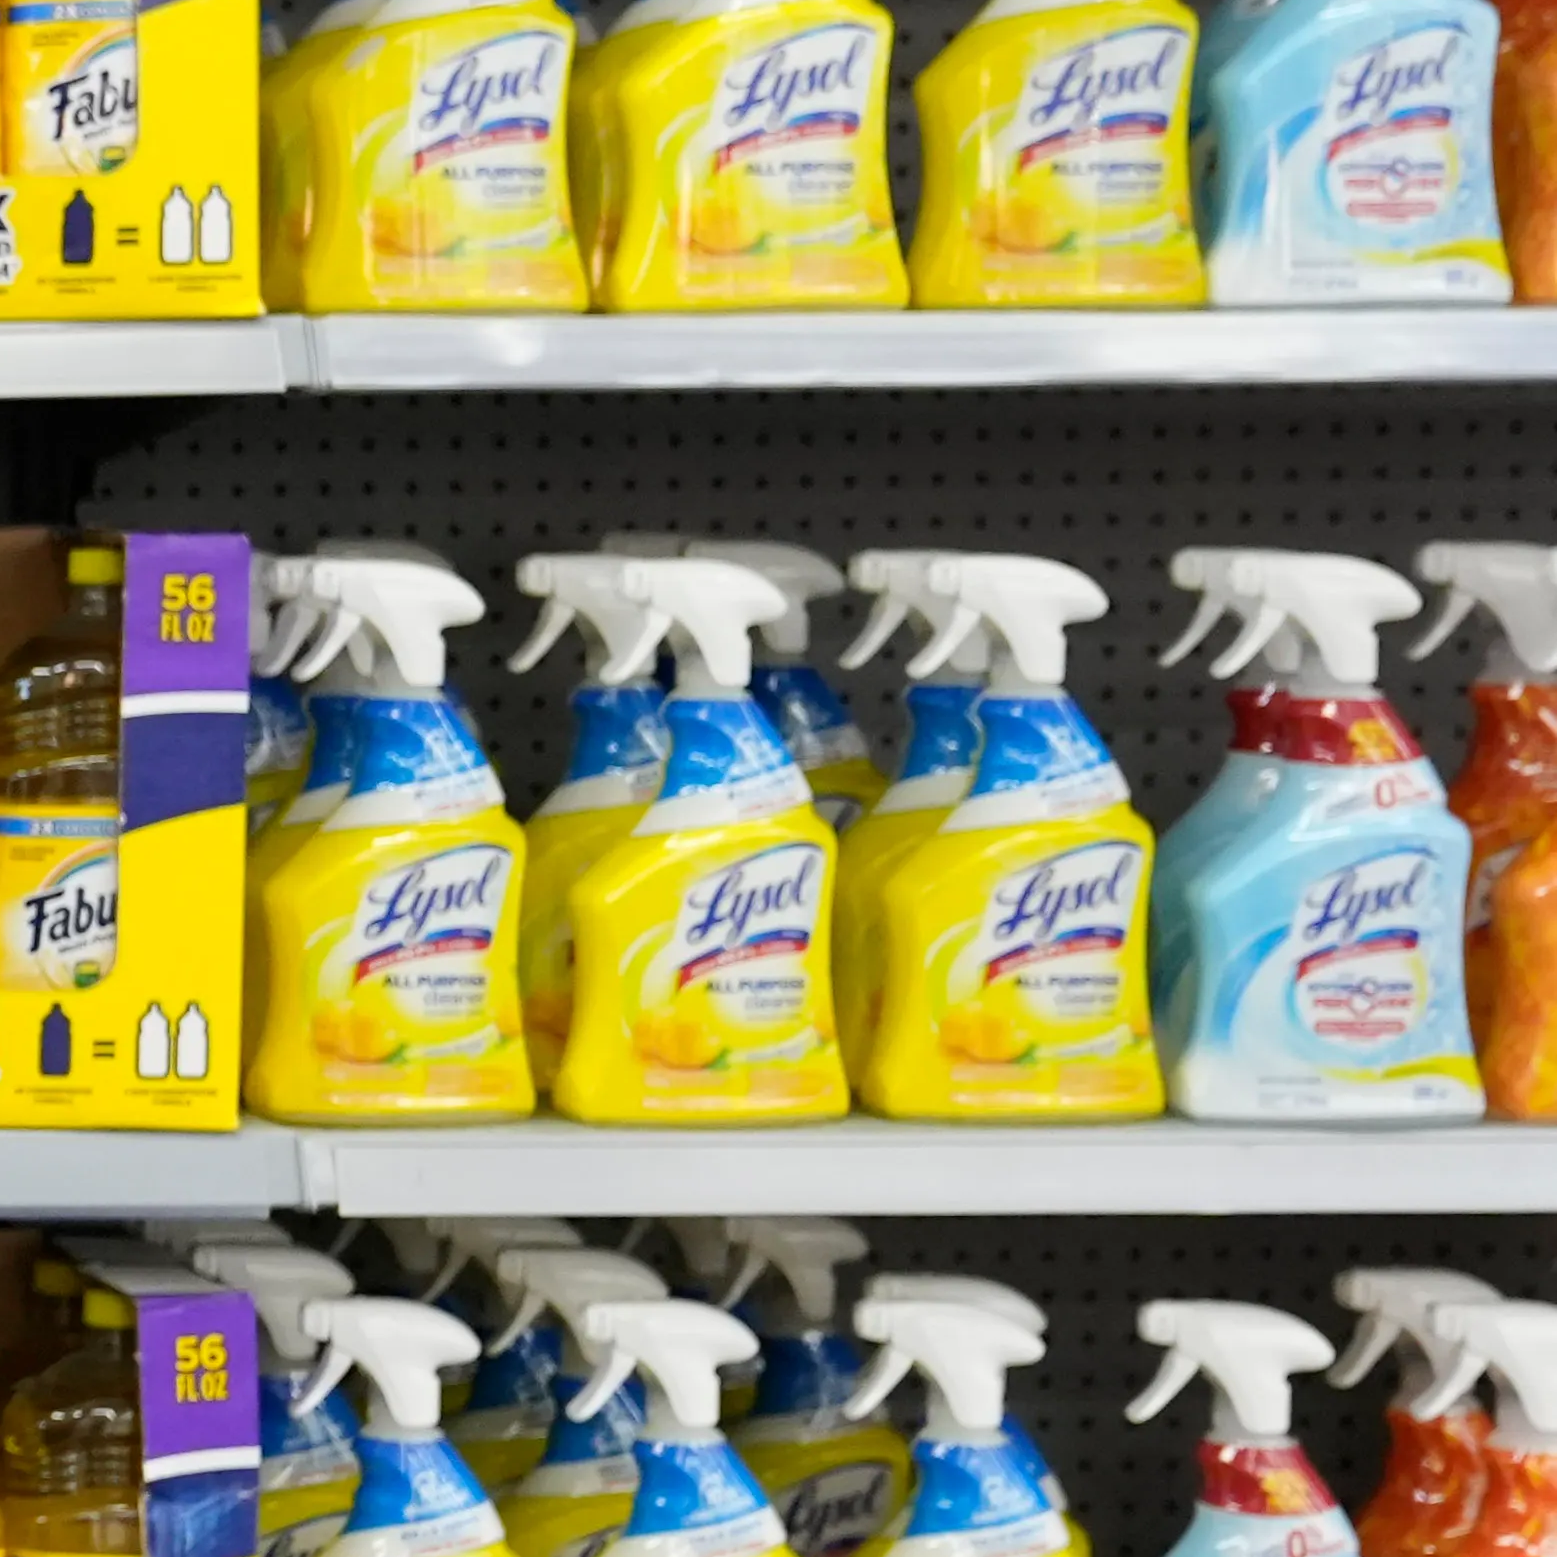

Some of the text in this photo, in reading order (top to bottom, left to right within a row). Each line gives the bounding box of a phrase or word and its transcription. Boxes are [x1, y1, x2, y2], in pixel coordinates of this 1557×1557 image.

[48, 75, 138, 142] Fabu
[419, 44, 555, 136] Lysol
[723, 38, 861, 135] Lysol
[1028, 38, 1179, 126] Lysol
[1335, 37, 1453, 122] Lysol
[161, 573, 216, 612] 56
[161, 613, 216, 643] FL OZ
[24, 887, 119, 954] Fabu
[364, 854, 502, 941] Lysol
[683, 851, 822, 942] Lysol
[993, 851, 1137, 943] Lysol
[1303, 859, 1426, 942] Lysol
[174, 1333, 228, 1372] 56
[175, 1372, 229, 1404] FL OZ
